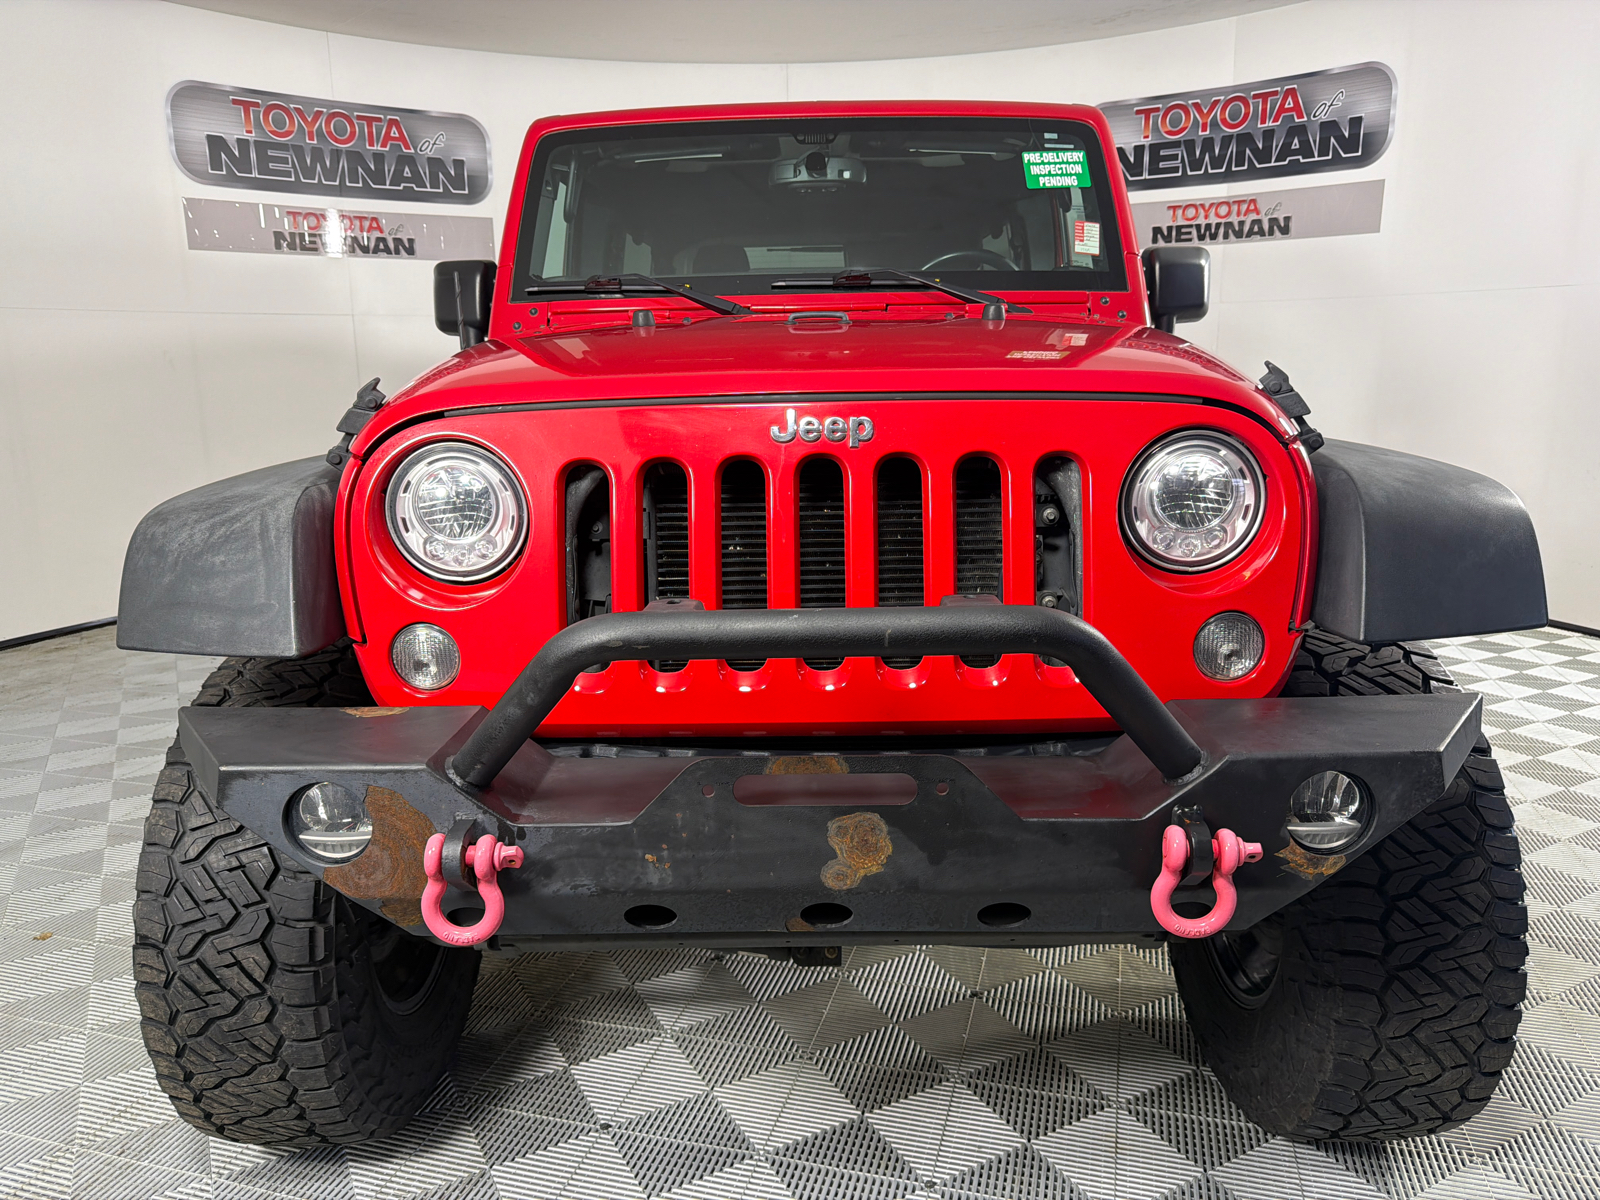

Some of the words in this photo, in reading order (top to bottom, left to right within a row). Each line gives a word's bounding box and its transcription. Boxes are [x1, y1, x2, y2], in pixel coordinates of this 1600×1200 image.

[229, 96, 414, 153] TOYOTA
[416, 132, 446, 154] of
[1134, 85, 1306, 141] TOYOTA
[1311, 89, 1345, 120] of
[1023, 151, 1084, 163] PRE-DELIVERY
[1115, 114, 1365, 181] NEWNAN
[204, 132, 469, 193] NEWNAN
[1030, 164, 1082, 175] INSPECTION
[1039, 176, 1078, 187] PENDING
[1166, 198, 1261, 223] TOYOTA
[1264, 202, 1282, 217] of
[272, 230, 416, 256] NENAN
[388, 224, 404, 236] of
[1151, 215, 1292, 244] NEWNAN
[770, 408, 874, 449] Jeep
